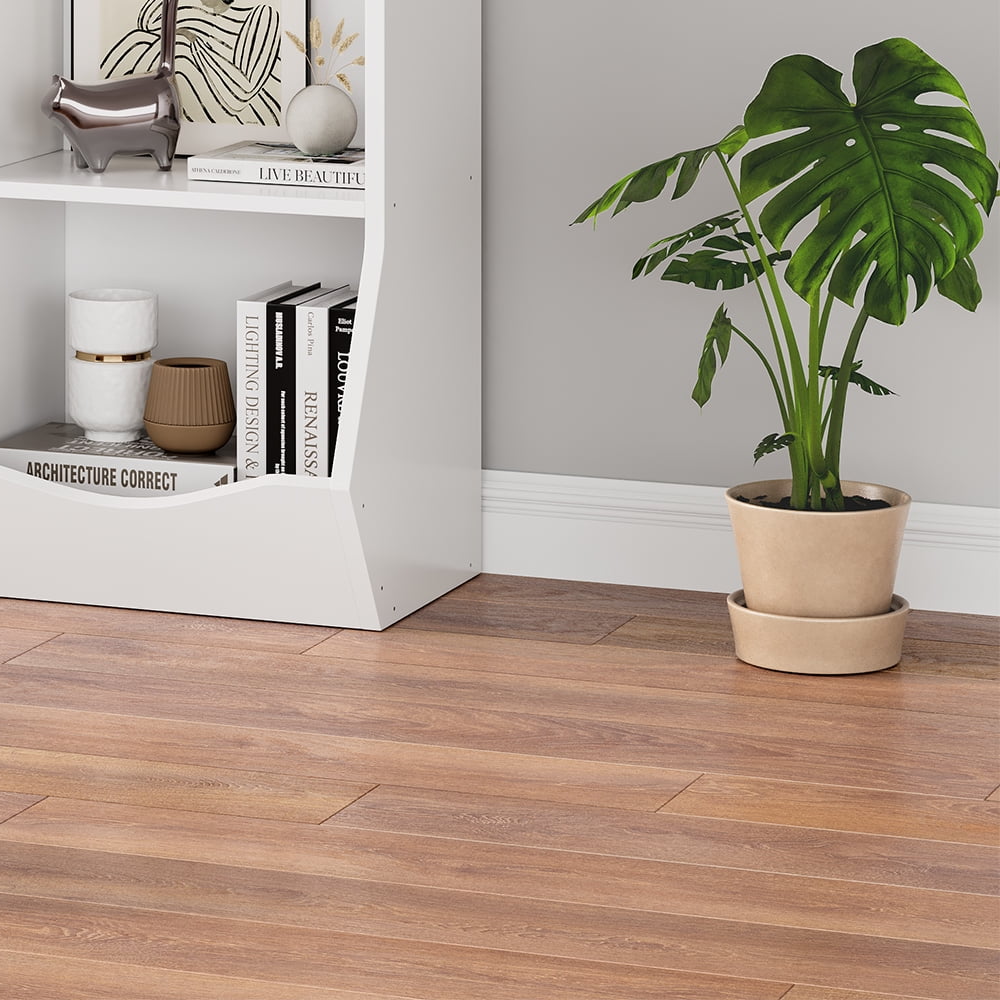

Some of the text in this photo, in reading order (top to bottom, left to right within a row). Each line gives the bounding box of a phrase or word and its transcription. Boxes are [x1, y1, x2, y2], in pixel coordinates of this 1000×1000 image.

[259, 167, 365, 185] LIVE BEAUTIFU
[307, 311, 315, 337] Carlos
[245, 315, 259, 392] LIGHTING
[245, 396, 259, 453] DESIGN
[26, 461, 178, 491] ARCHITECTURE CORRECT
[245, 457, 259, 470] &
